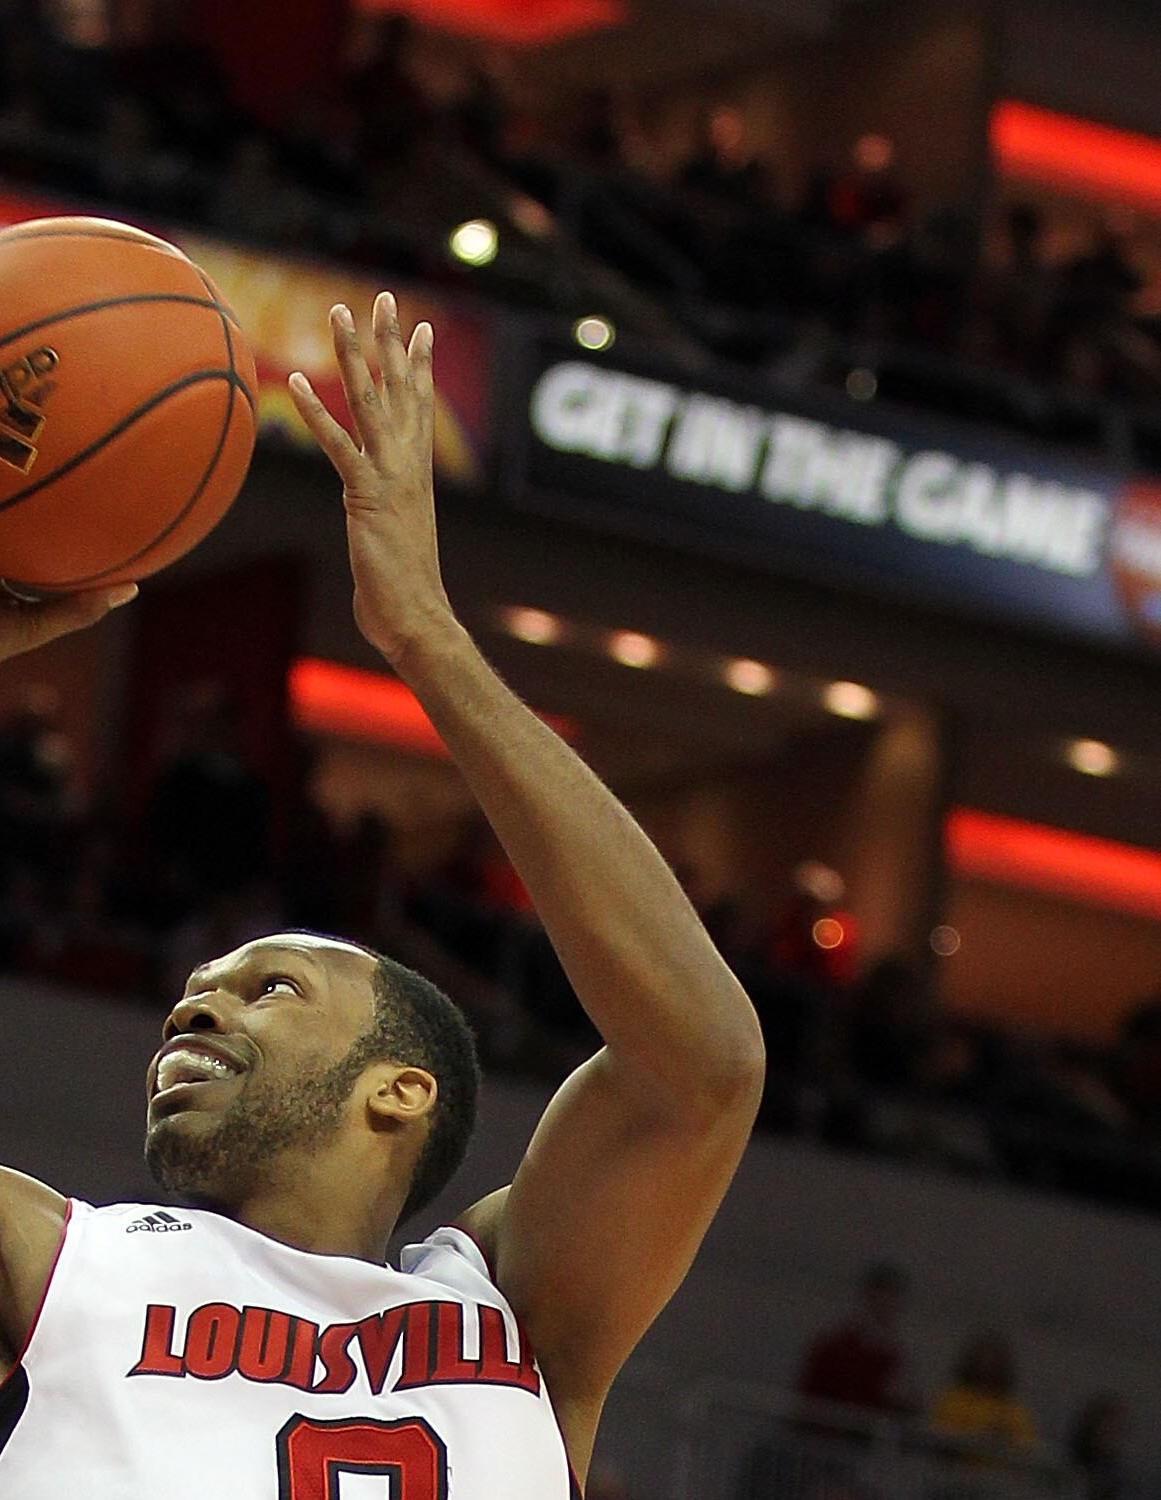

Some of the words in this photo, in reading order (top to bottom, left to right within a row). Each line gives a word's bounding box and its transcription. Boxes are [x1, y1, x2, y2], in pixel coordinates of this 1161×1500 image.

[533, 362, 675, 468] GET
[669, 392, 761, 490] IN
[761, 412, 897, 522] THE
[899, 450, 1105, 574] GAME
[125, 1218, 193, 1233] adidas
